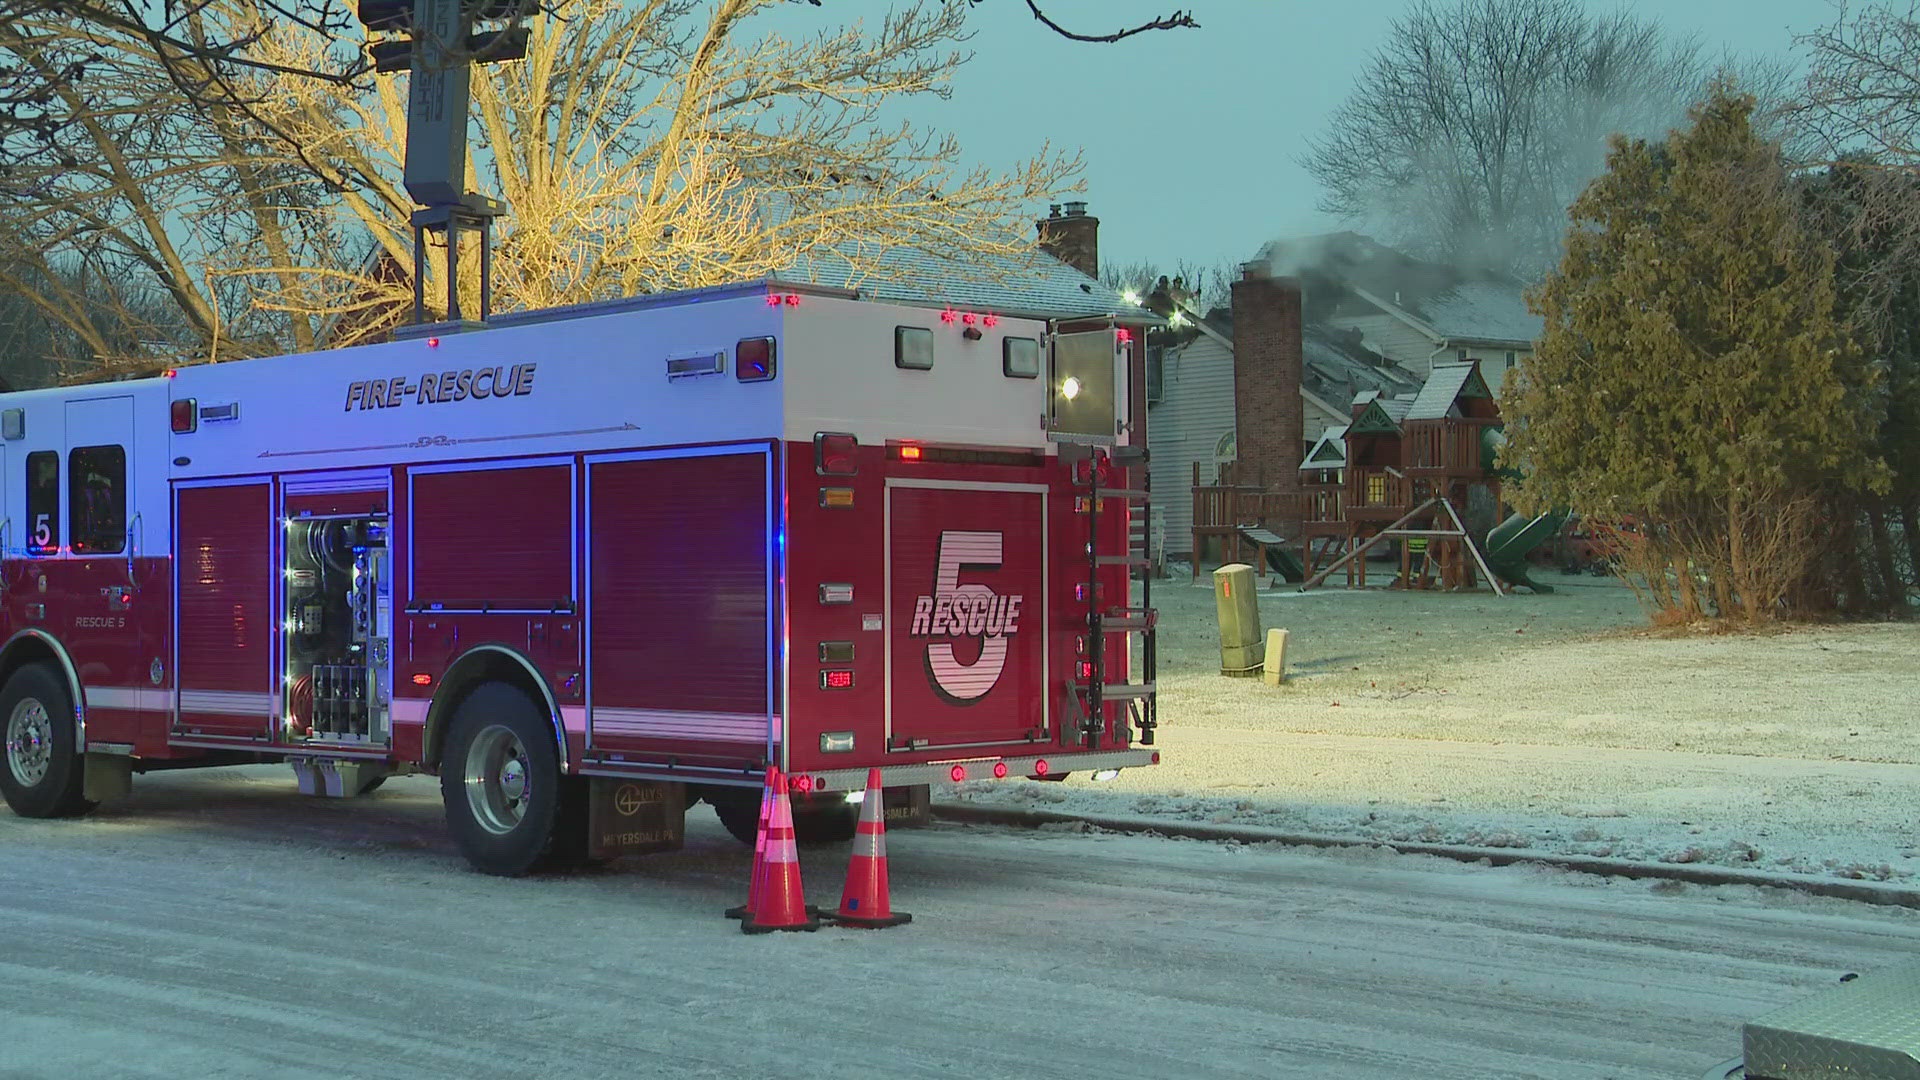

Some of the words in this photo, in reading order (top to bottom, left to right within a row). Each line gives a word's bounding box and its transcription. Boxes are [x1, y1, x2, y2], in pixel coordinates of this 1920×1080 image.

[345, 363, 536, 411] FIRE-RESCUE
[35, 513, 50, 546] 5
[75, 616, 115, 628] RESCUE
[118, 617, 126, 628] 5
[910, 593, 1022, 638] RESCUE
[925, 530, 1008, 704] 5
